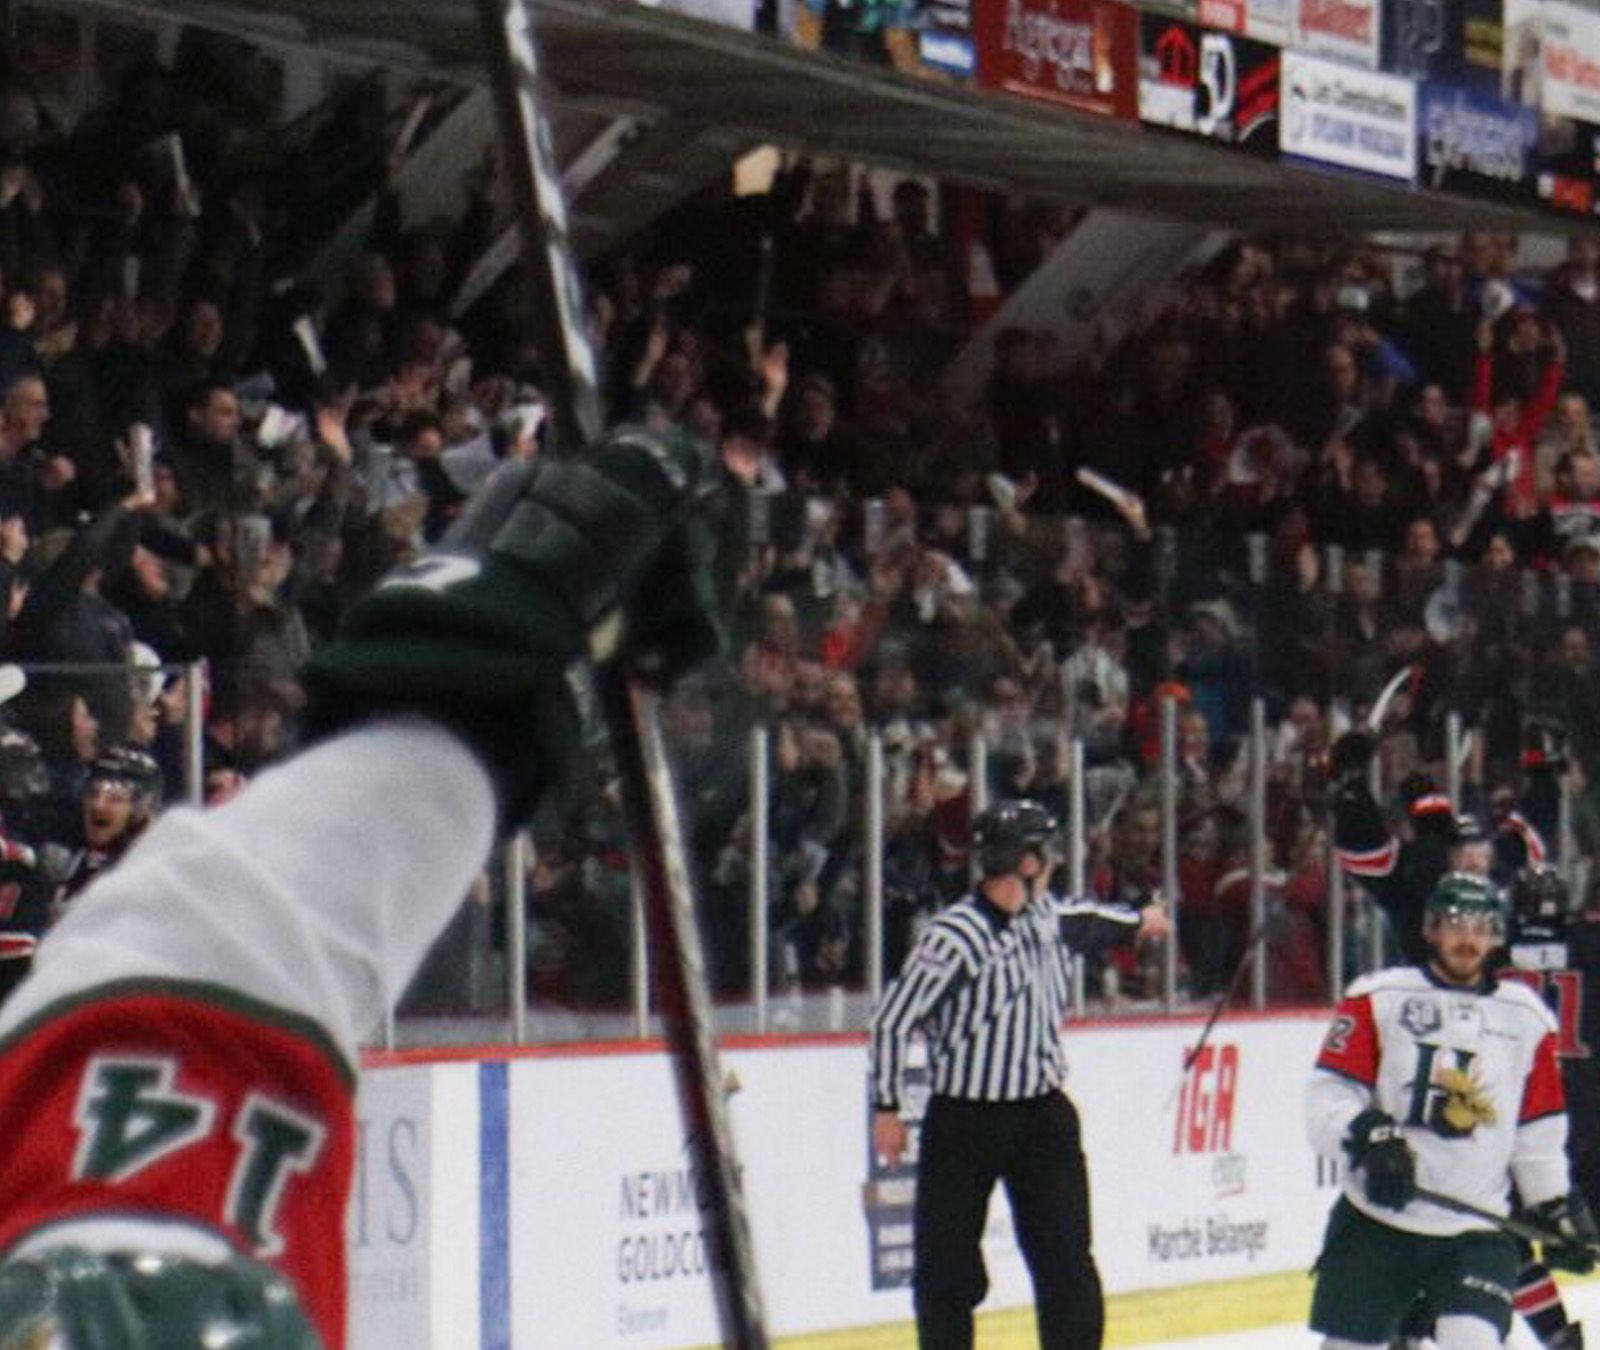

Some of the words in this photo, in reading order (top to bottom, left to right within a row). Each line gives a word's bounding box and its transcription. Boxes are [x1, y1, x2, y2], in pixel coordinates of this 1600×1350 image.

[71, 1051, 327, 1258] 14
[355, 1114, 420, 1248] IS
[619, 1168, 700, 1220] NEWM
[617, 1230, 706, 1284] GOLDCO
